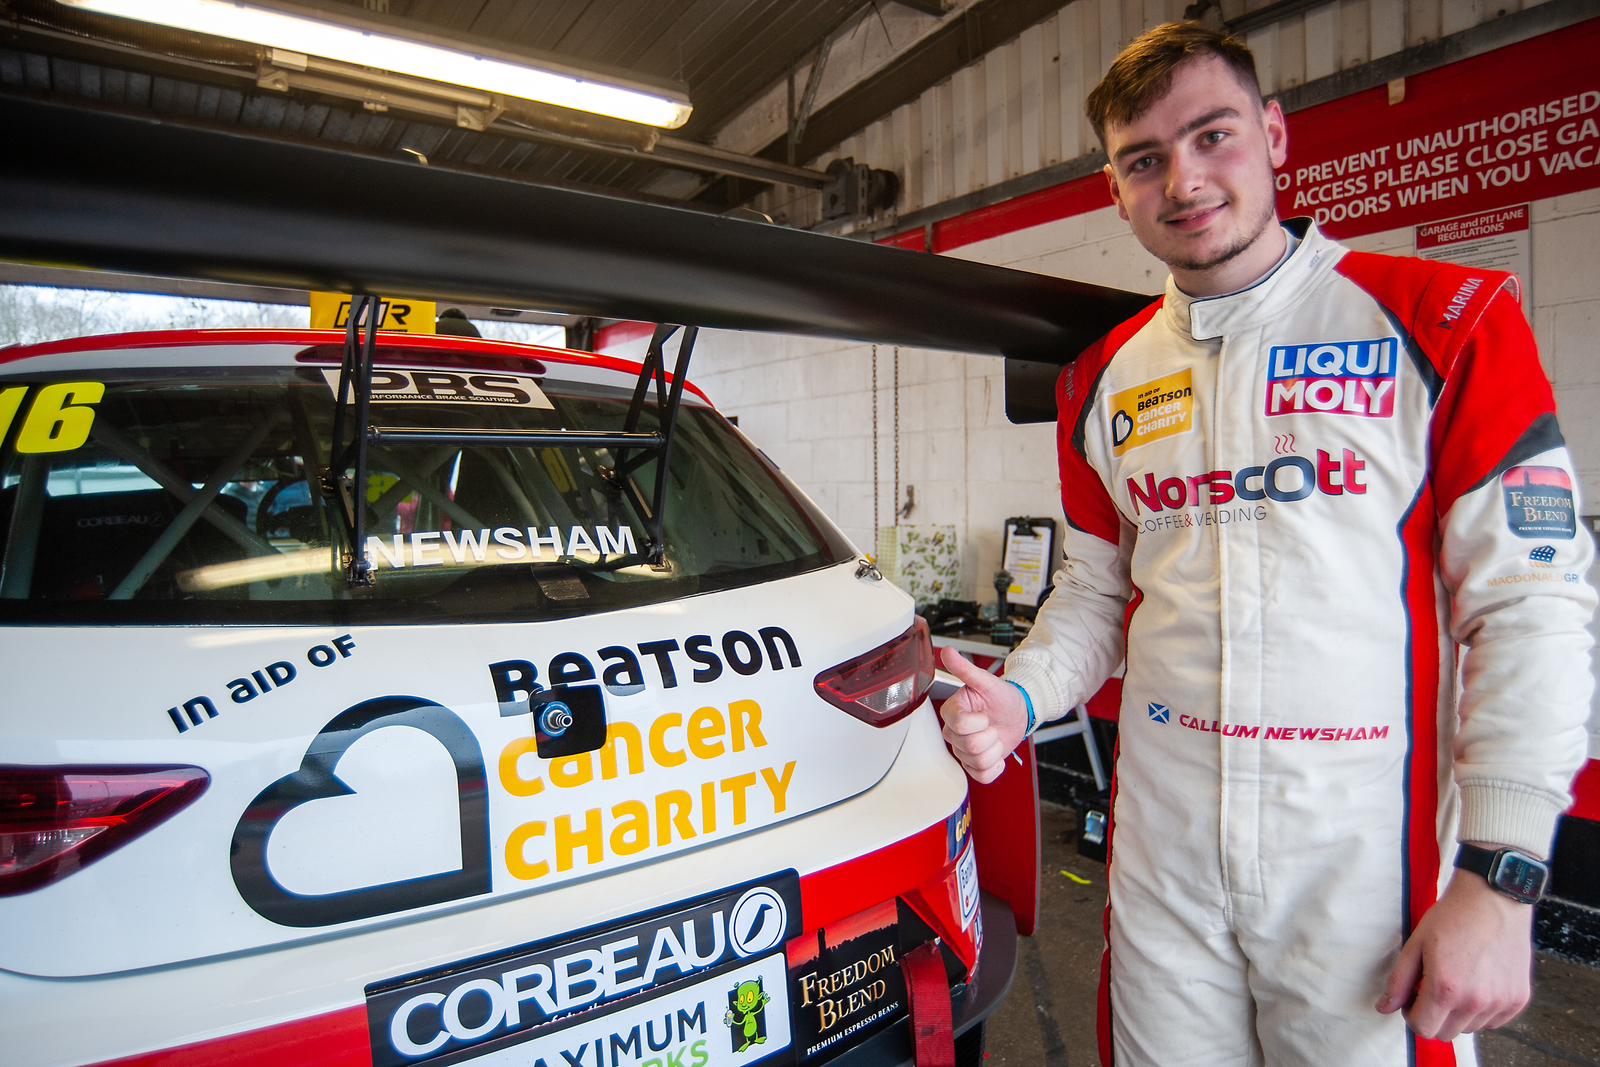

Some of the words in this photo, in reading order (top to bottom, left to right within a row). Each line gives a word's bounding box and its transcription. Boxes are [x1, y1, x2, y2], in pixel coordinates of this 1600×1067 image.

[1273, 173, 1291, 191] O
[1296, 146, 1390, 186] PREVENT
[1396, 91, 1600, 160] UNAUTHORISED
[1293, 175, 1368, 209] ACCESS
[1374, 152, 1459, 190] PLEASE
[1465, 130, 1549, 167] CLOSE
[1314, 193, 1391, 226] DOORS
[1397, 174, 1469, 208] WHEN
[1476, 160, 1531, 190] YOU
[1420, 222, 1459, 237] GARAGE
[1460, 218, 1479, 229] and
[1480, 214, 1496, 226] PIT
[1497, 209, 1524, 222] LANE
[1437, 222, 1505, 242] REGULATIONS
[1437, 278, 1484, 330] MARINA
[1273, 341, 1391, 378] LIQUI
[1270, 379, 1394, 414] MOLY
[77, 515, 148, 528] CORBEAU
[1509, 491, 1572, 509] FREEDOM
[1523, 507, 1568, 522] BLEND
[366, 525, 638, 571] NEWSHAM
[307, 633, 357, 668] OF
[1179, 713, 1261, 739] CALLUM
[1263, 725, 1390, 741] NEWSHAM
[391, 910, 727, 1057] CORBEAU
[798, 944, 896, 1008] FREEDOM
[806, 1031, 844, 1056] PREMIUM
[843, 1012, 878, 1037] ESPRESSO
[877, 1001, 900, 1018] BEANS
[815, 979, 887, 1034] BLEND
[533, 1001, 708, 1067] XIMUM
